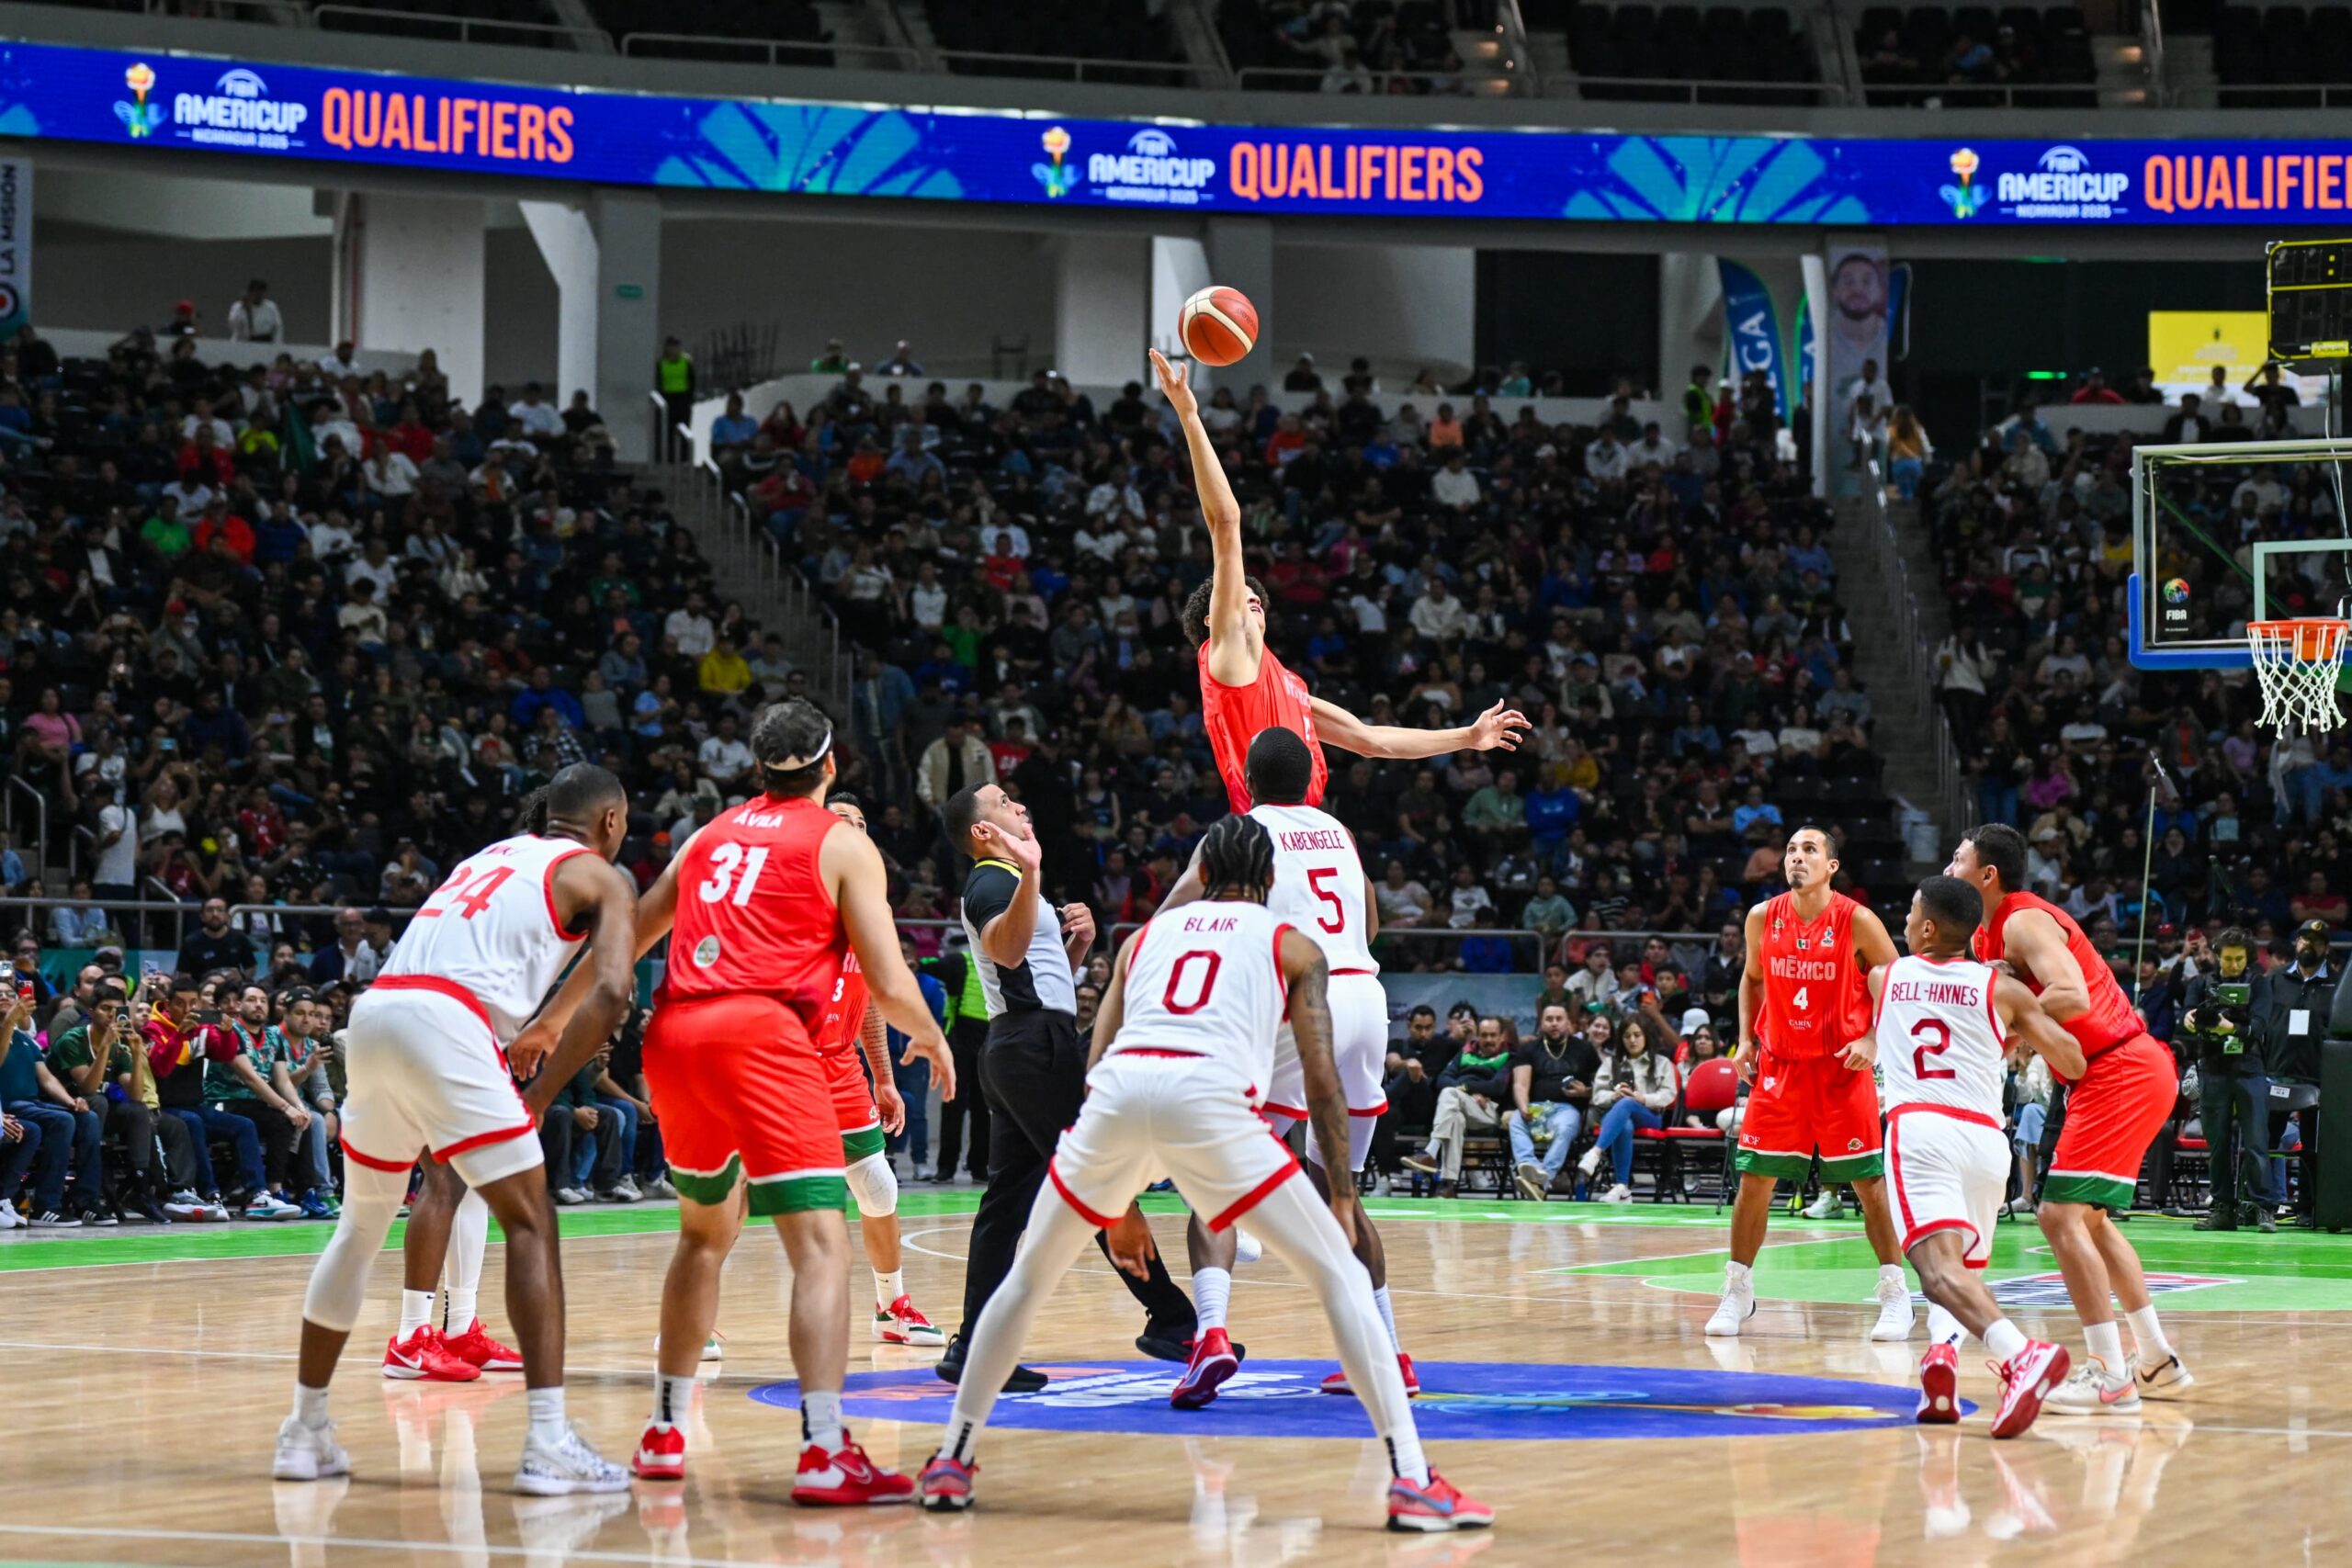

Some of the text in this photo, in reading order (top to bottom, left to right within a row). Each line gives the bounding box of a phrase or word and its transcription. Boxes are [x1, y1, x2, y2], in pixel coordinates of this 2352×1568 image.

[175, 93, 308, 133] AMERICUP
[322, 87, 574, 163] QUALIFIERS
[1089, 153, 1216, 187] AMERICUP
[1230, 141, 1484, 202] QUALIFIERS
[2144, 154, 2352, 214] QUALIFIE
[1998, 173, 2129, 202] AMERICUP
[2165, 609, 2187, 621] FIBA
[732, 809, 784, 828] ÁVILA
[1279, 829, 1345, 852] KABENGELE
[698, 842, 770, 907] 31
[413, 866, 516, 920] 24
[1306, 867, 1345, 934] 5
[1184, 917, 1238, 932] BLAIR
[1162, 950, 1222, 1015] 0
[1770, 955, 1837, 982] MÉXICO
[831, 977, 845, 1002] 3
[1792, 987, 1808, 1010] 4
[1891, 982, 1979, 1008] BELL-HAYNES
[1911, 1018, 1956, 1080] 2
